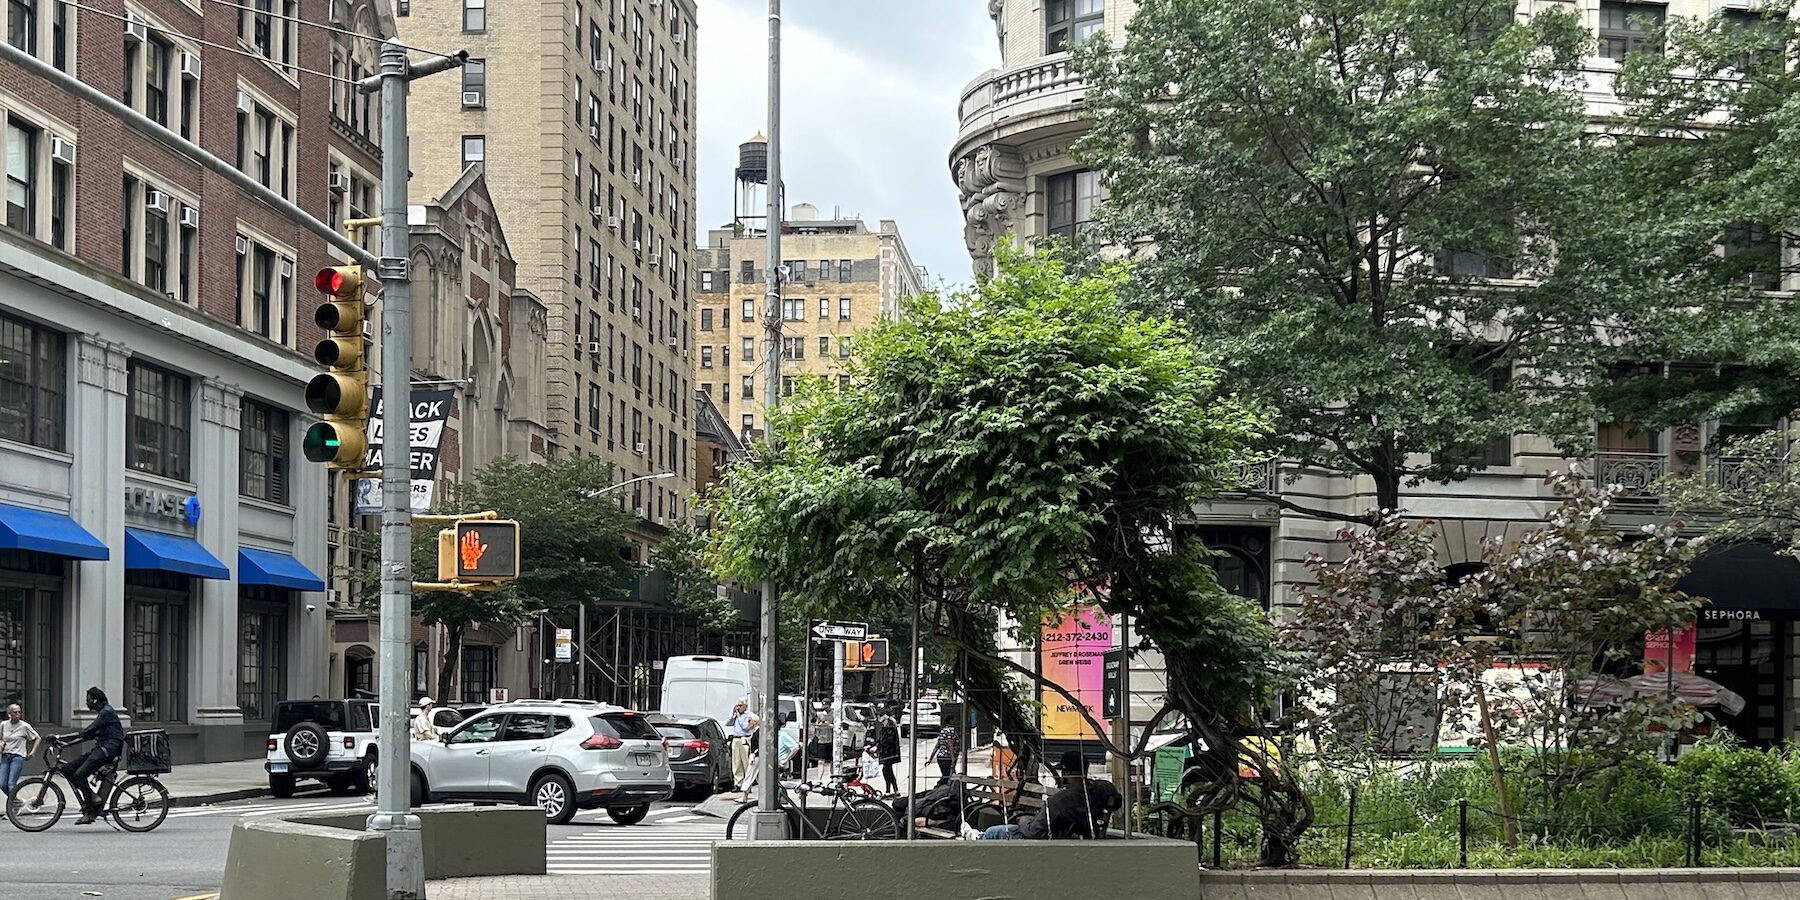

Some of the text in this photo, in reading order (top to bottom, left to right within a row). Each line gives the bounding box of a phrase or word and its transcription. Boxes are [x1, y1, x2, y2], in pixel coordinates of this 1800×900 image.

[374, 425, 429, 441] LES
[133, 487, 187, 519] CHASE
[1704, 610, 1760, 620] SEPHORA
[1046, 632, 1108, 641] 212-372-2430
